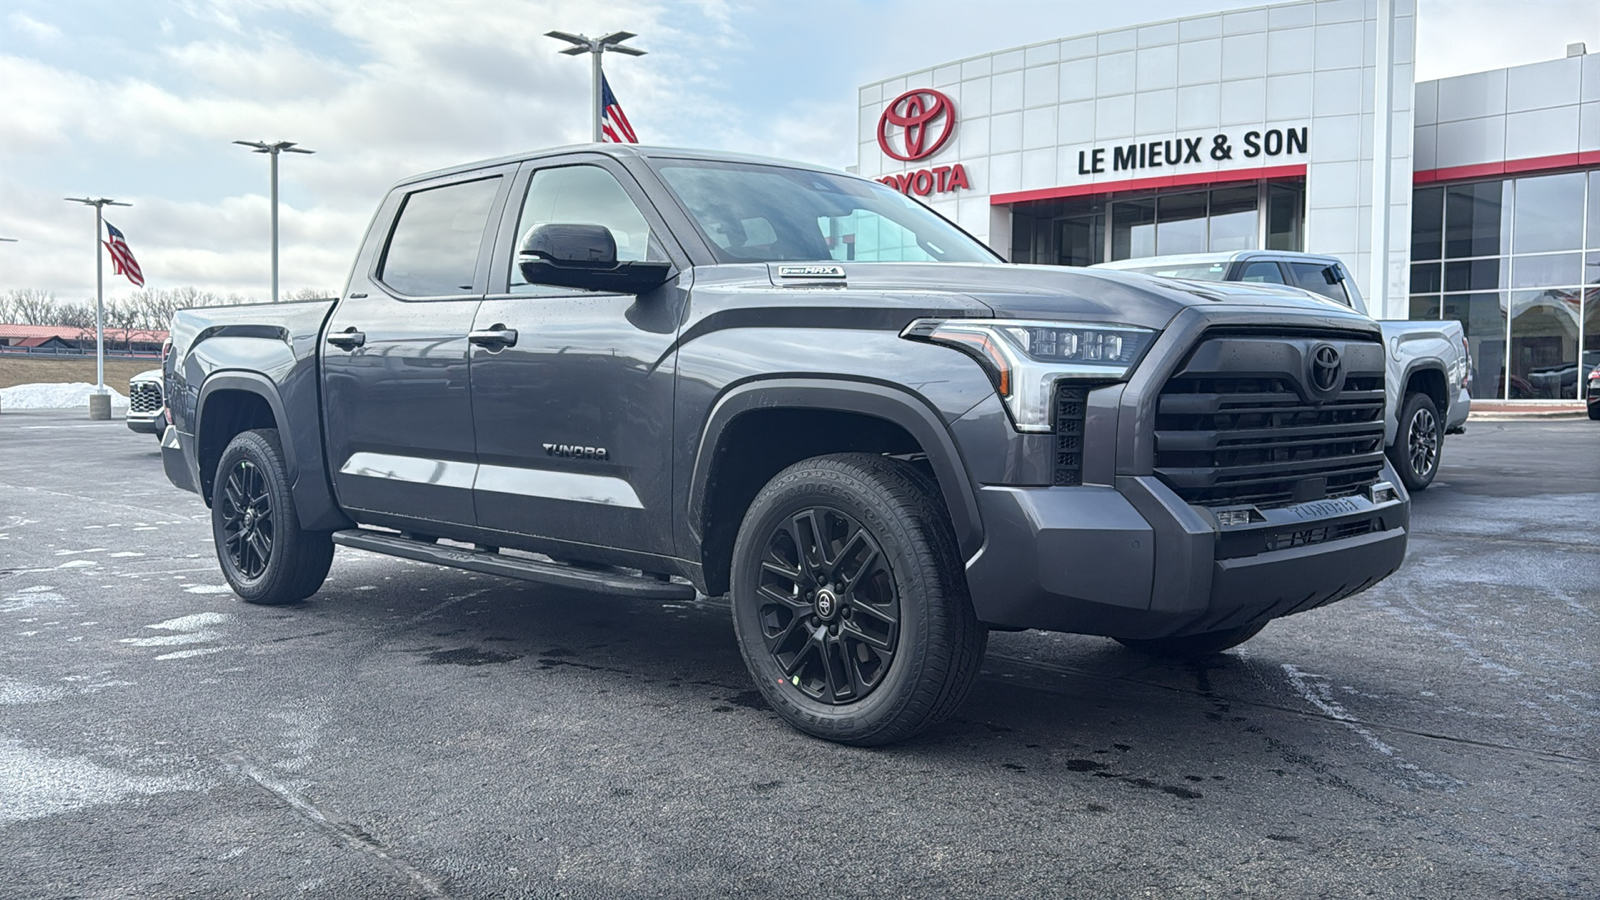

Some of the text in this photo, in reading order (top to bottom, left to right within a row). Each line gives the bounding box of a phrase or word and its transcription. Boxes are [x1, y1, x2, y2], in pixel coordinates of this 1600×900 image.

[1078, 127, 1308, 175] LE MIEUX & SON
[875, 163, 970, 196] OYOTA
[542, 443, 609, 461] TUNDRA
